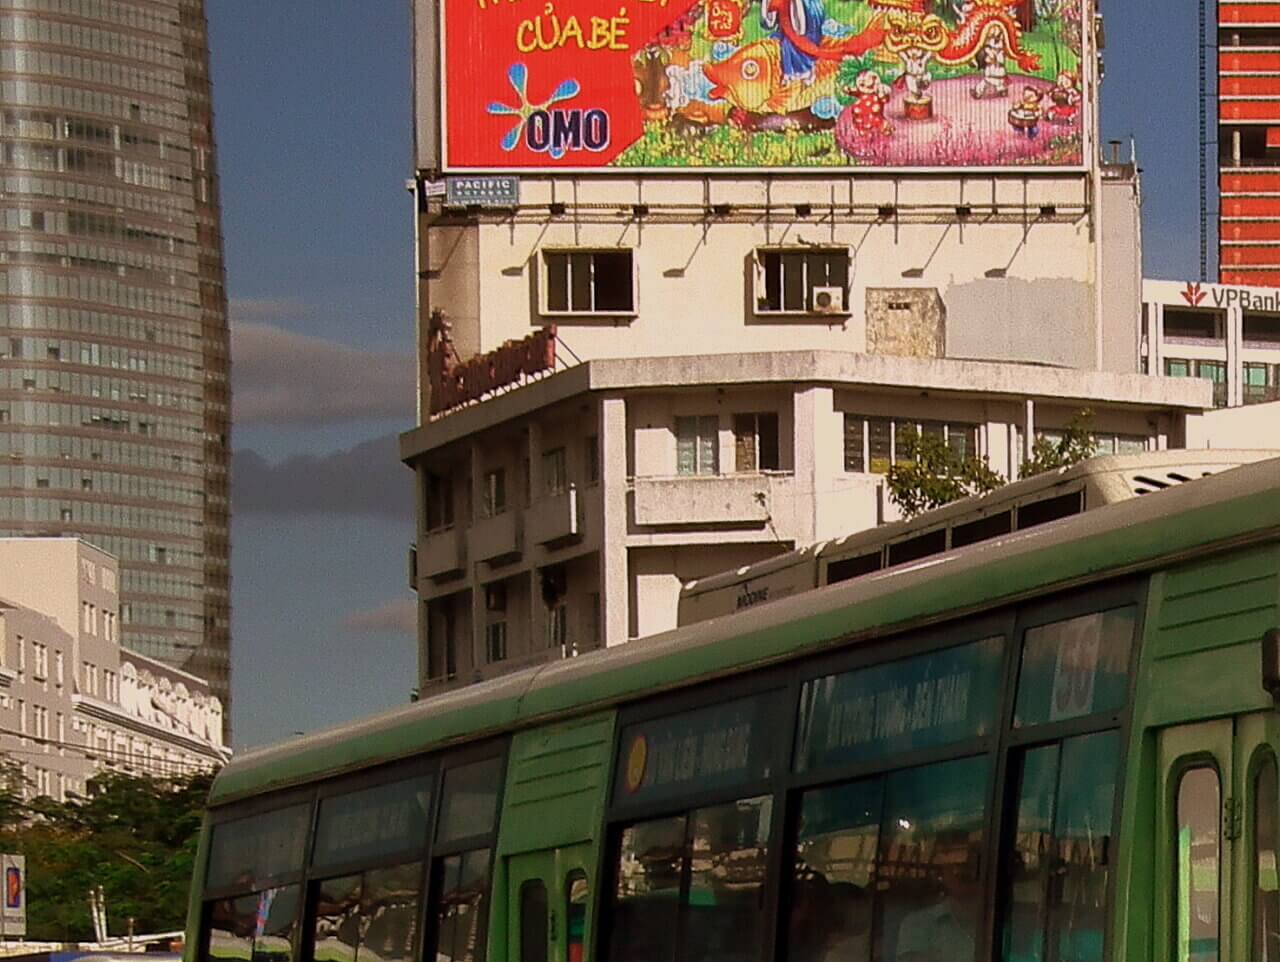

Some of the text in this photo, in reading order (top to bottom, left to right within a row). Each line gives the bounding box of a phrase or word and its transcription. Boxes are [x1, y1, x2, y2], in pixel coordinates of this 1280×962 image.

[517, 2, 630, 52] CỦA BÉ
[526, 109, 609, 151] OMO
[456, 180, 510, 189] PACIFIC
